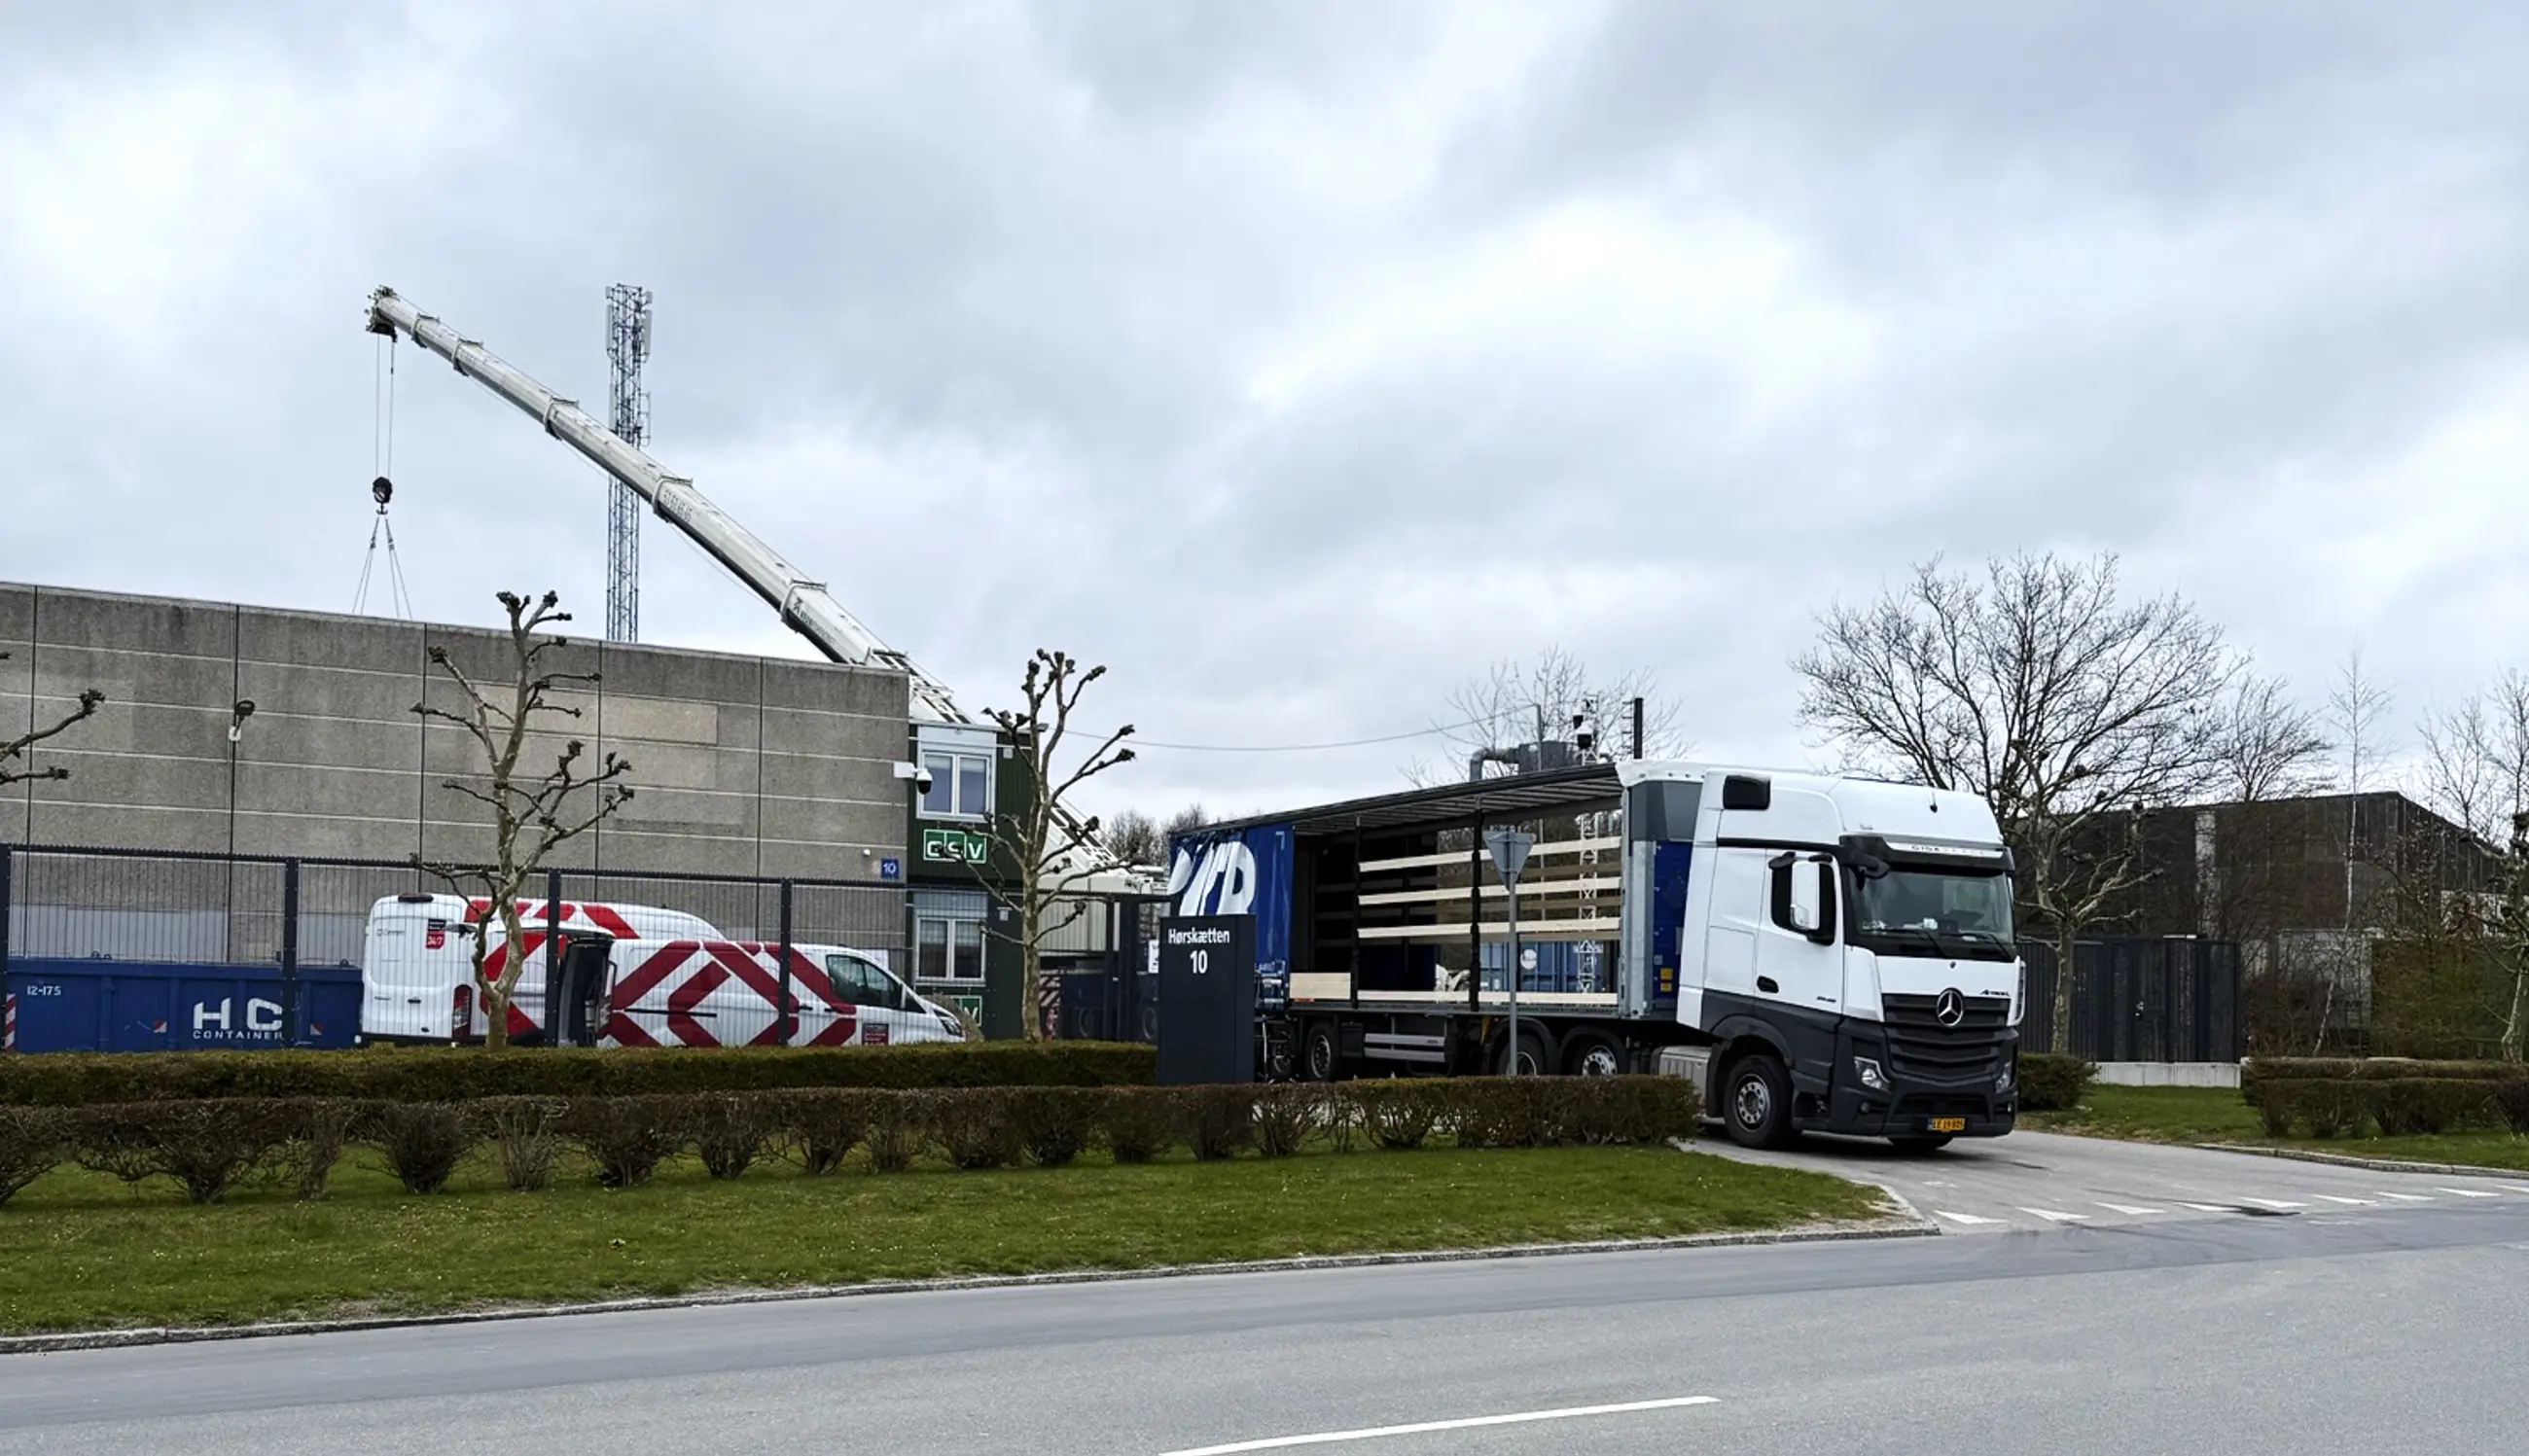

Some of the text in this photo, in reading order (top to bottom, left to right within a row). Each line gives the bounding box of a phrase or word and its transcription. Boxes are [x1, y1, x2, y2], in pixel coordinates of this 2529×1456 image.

[882, 863, 897, 874] 10
[1168, 927, 1229, 944] Hørskætten
[1190, 948, 1208, 975] 10
[26, 984, 62, 996] 12-175
